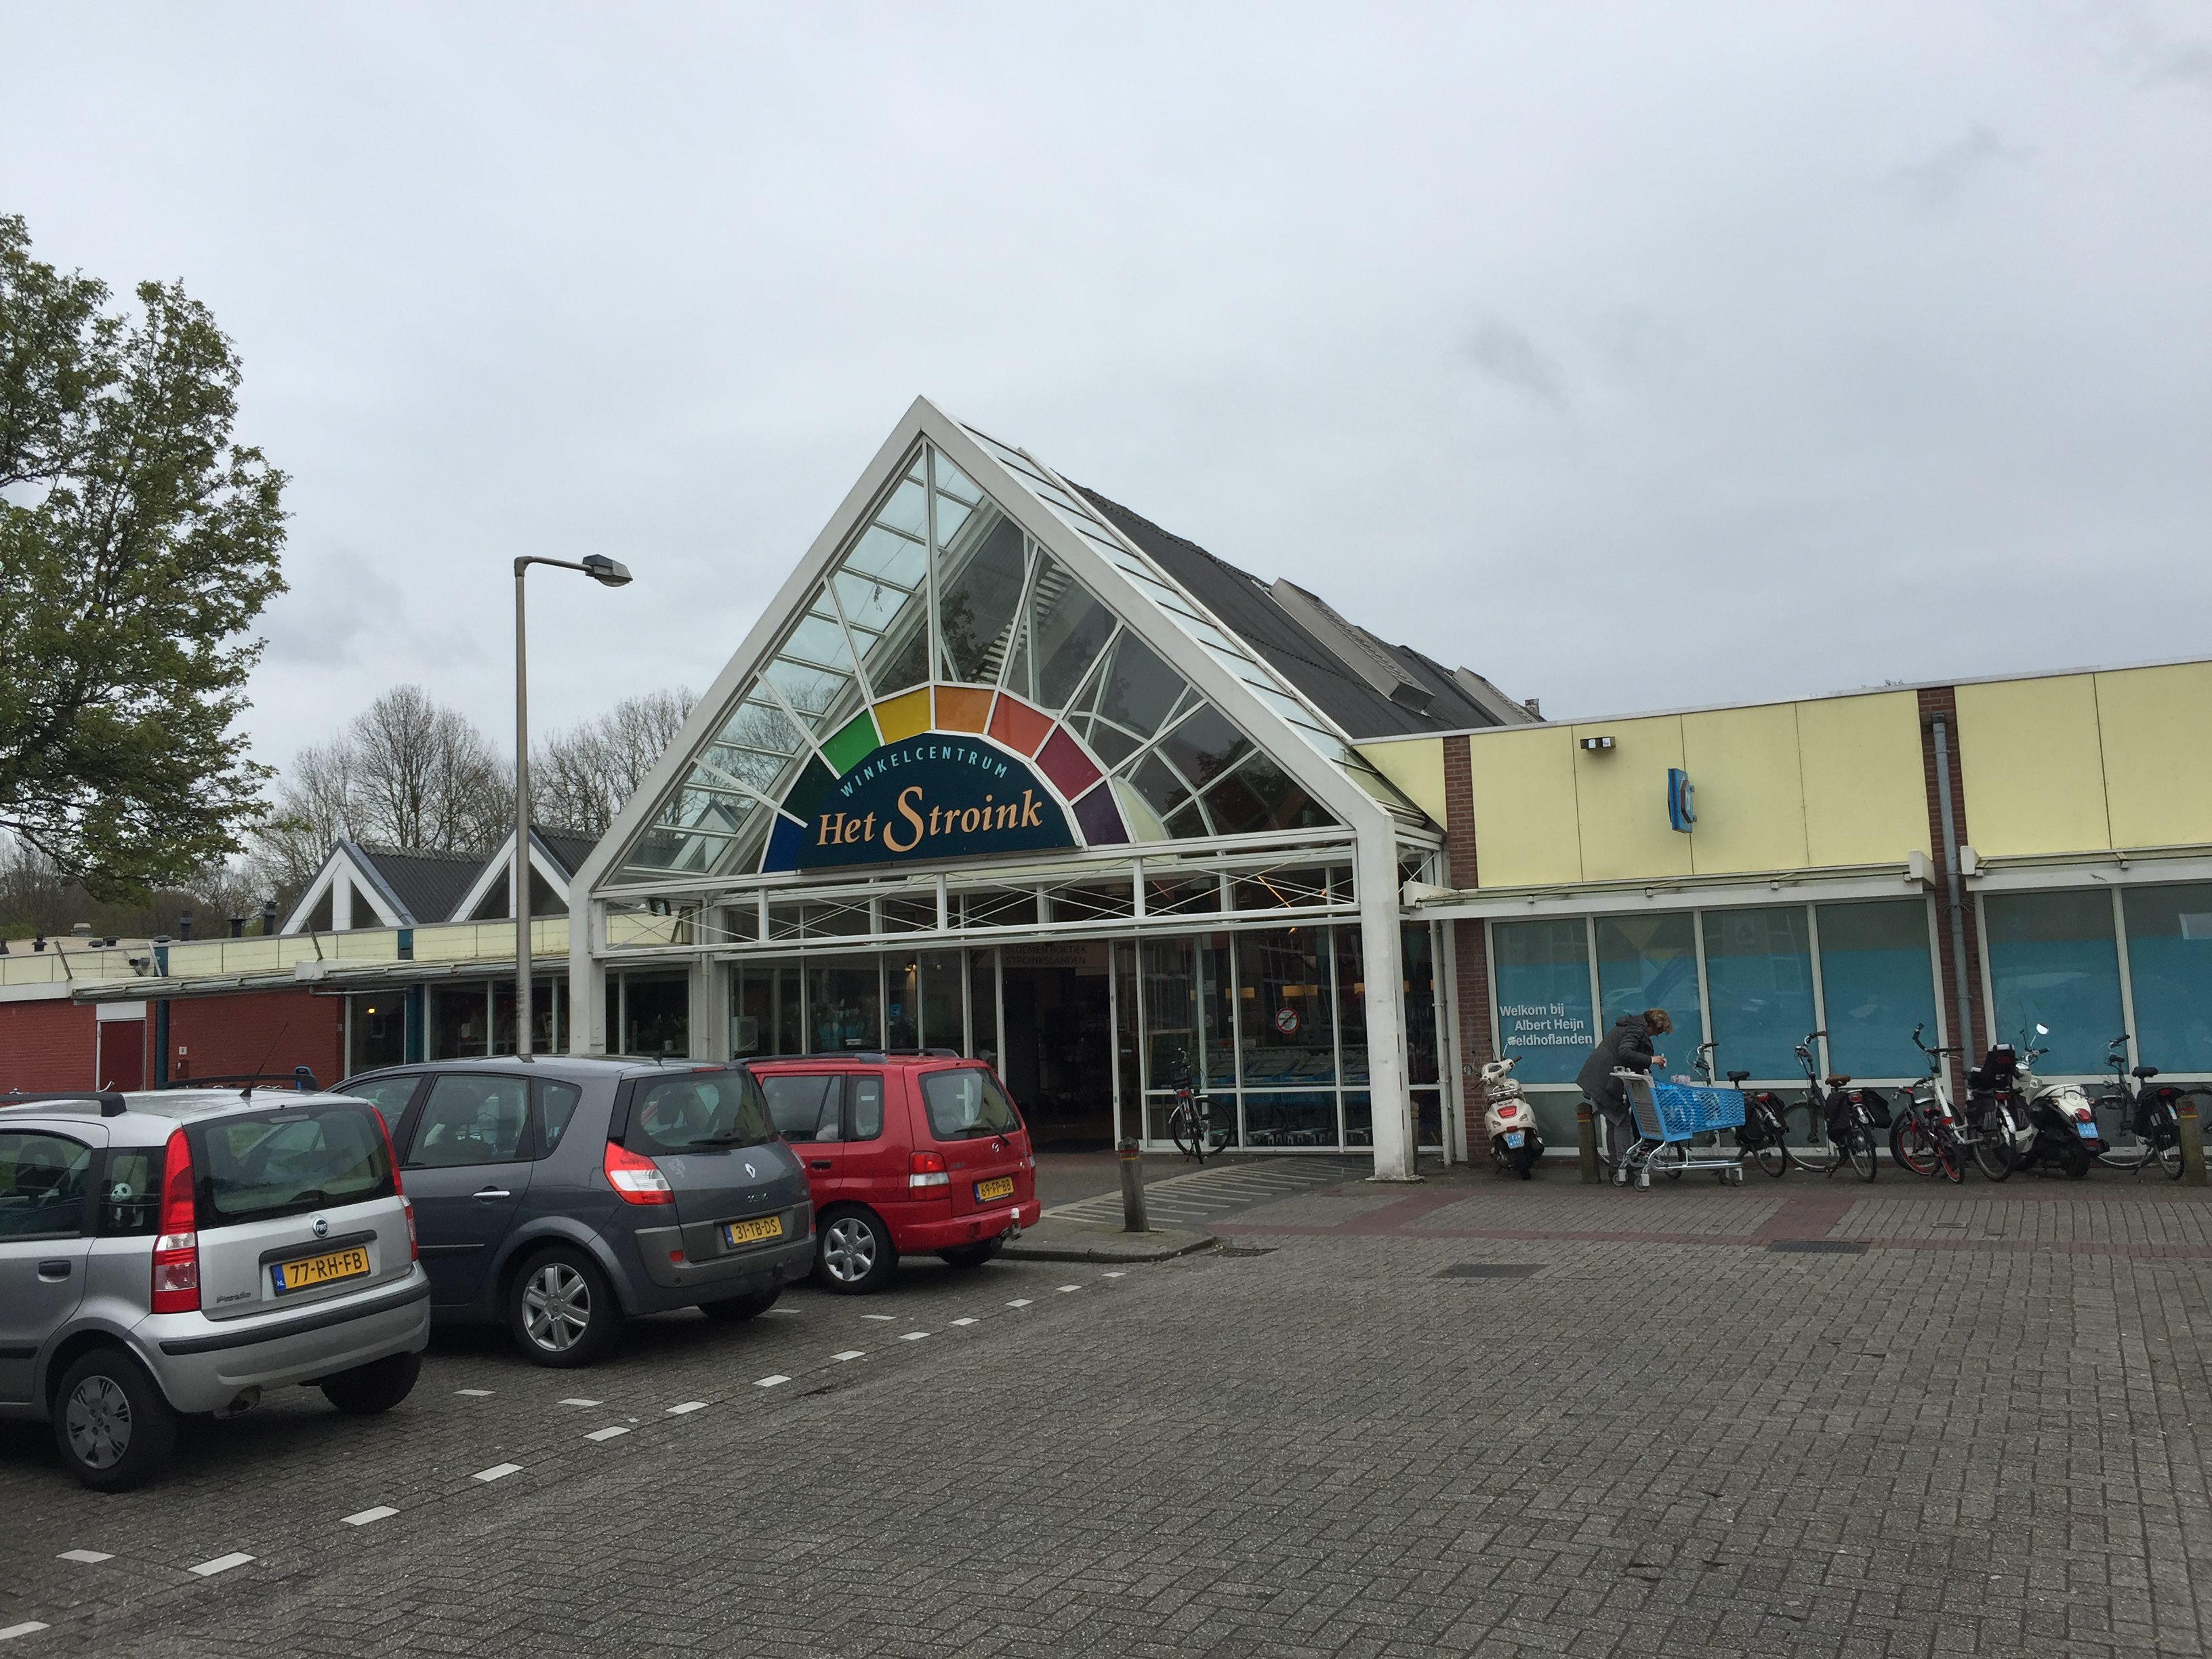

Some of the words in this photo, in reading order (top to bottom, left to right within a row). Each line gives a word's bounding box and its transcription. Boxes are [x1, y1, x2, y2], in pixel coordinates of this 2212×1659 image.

[840, 745, 1008, 798] WINKELCENTRUM
[816, 811, 877, 846] Het
[883, 785, 1043, 853] Stroink
[1499, 1004, 1547, 1017] Welkom
[1550, 1003, 1564, 1017] bij
[1515, 1019, 1552, 1031] Albert
[1554, 1018, 1584, 1031] Heijn
[1509, 1032, 1593, 1046] eldhoflanden
[735, 1218, 777, 1240] 31-TB-DS
[290, 1251, 363, 1284] 77-RH-FB
